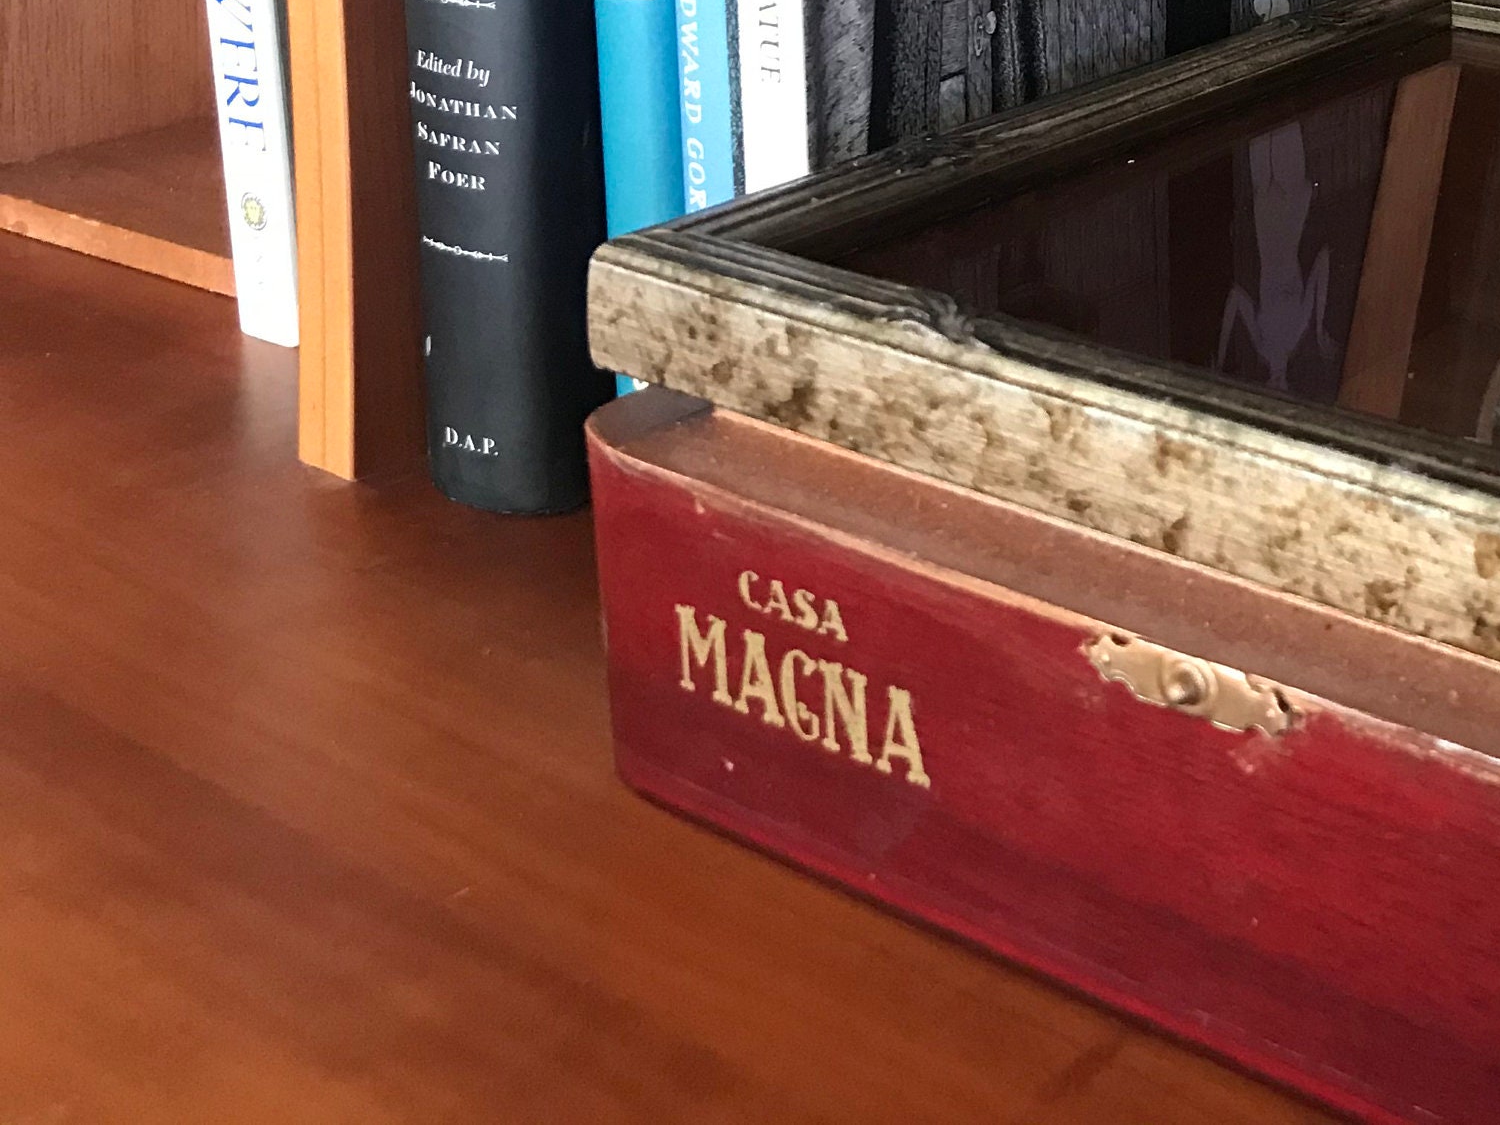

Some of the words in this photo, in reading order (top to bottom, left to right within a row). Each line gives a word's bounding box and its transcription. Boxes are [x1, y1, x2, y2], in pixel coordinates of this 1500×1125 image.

[416, 49, 463, 77] Edited
[466, 60, 490, 87] by
[409, 81, 518, 120] JONATHAN
[416, 121, 501, 155] SAFRAN
[427, 160, 486, 190] FOER
[444, 426, 499, 456] D.A.P.
[738, 570, 849, 643] CASA
[675, 604, 931, 788] MAGNA
